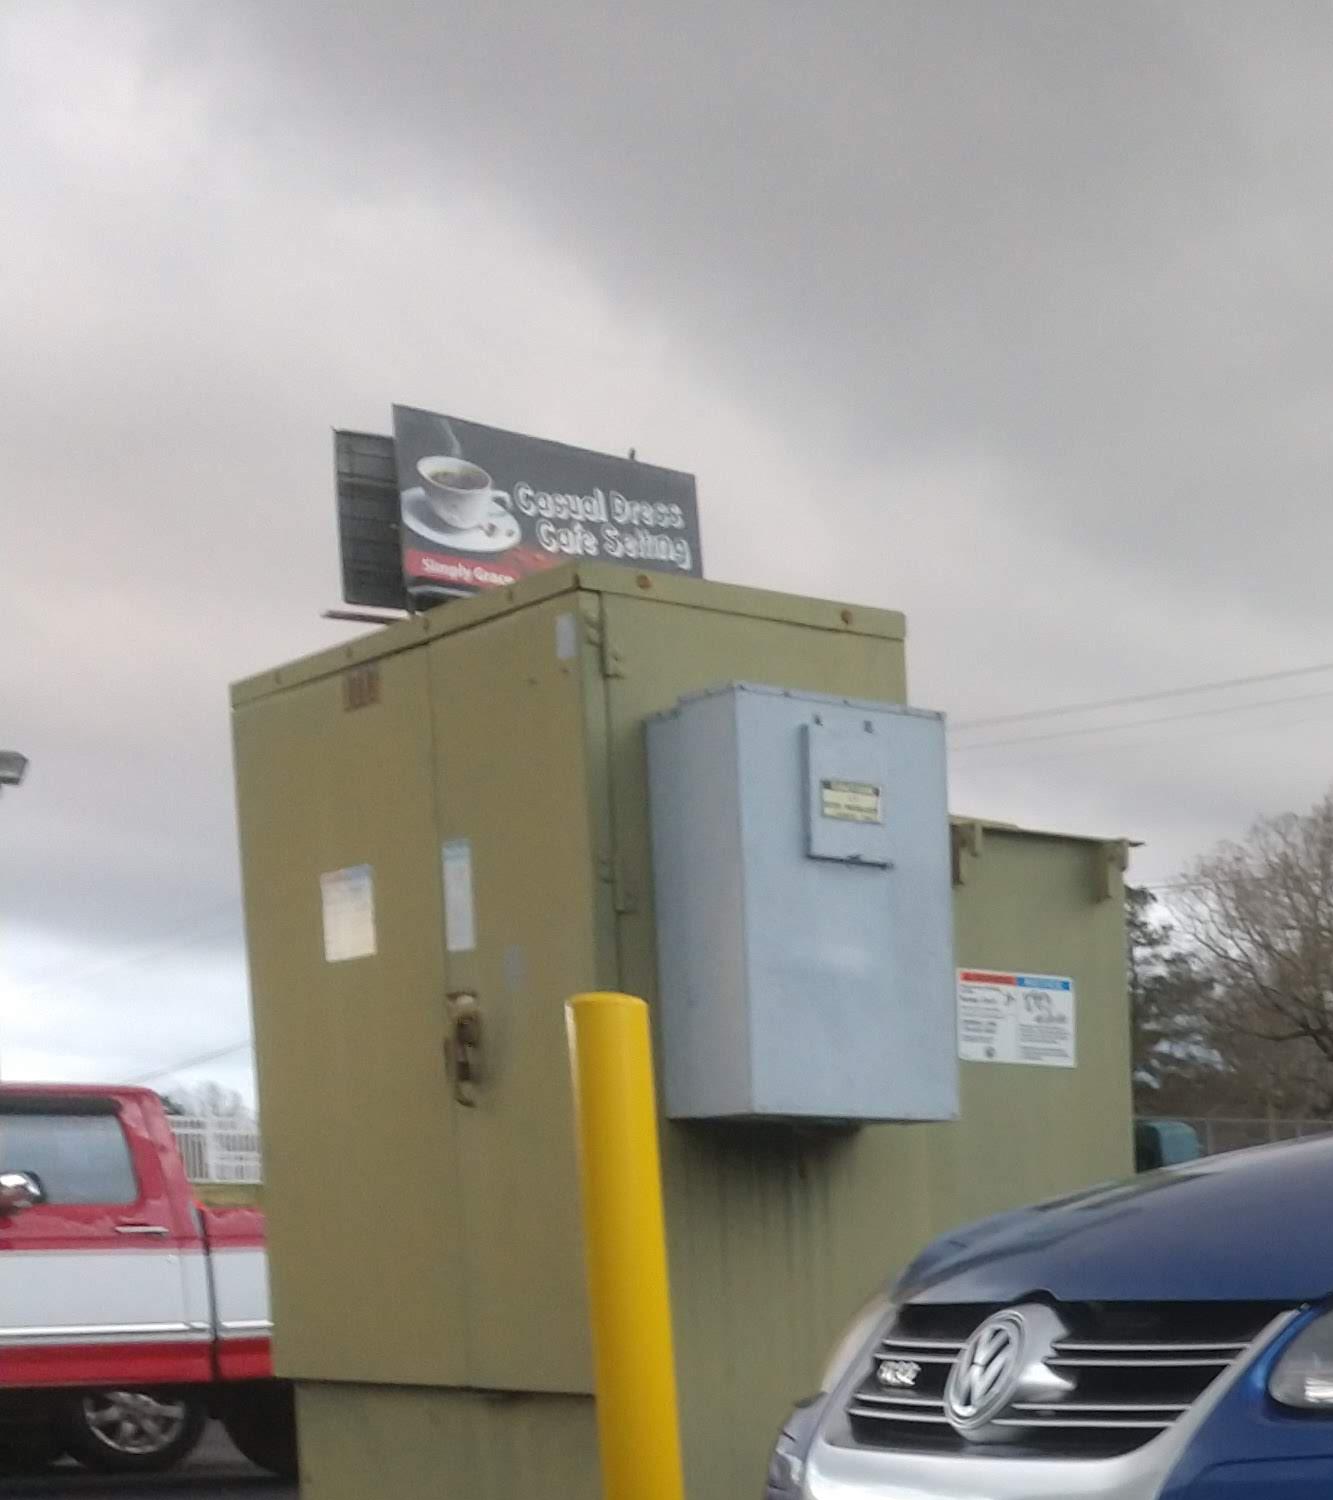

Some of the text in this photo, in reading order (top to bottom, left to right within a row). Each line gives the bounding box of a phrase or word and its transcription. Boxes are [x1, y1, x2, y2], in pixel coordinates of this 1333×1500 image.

[514, 481, 685, 530] Casual Dress
[536, 518, 692, 570] Cafe Setting
